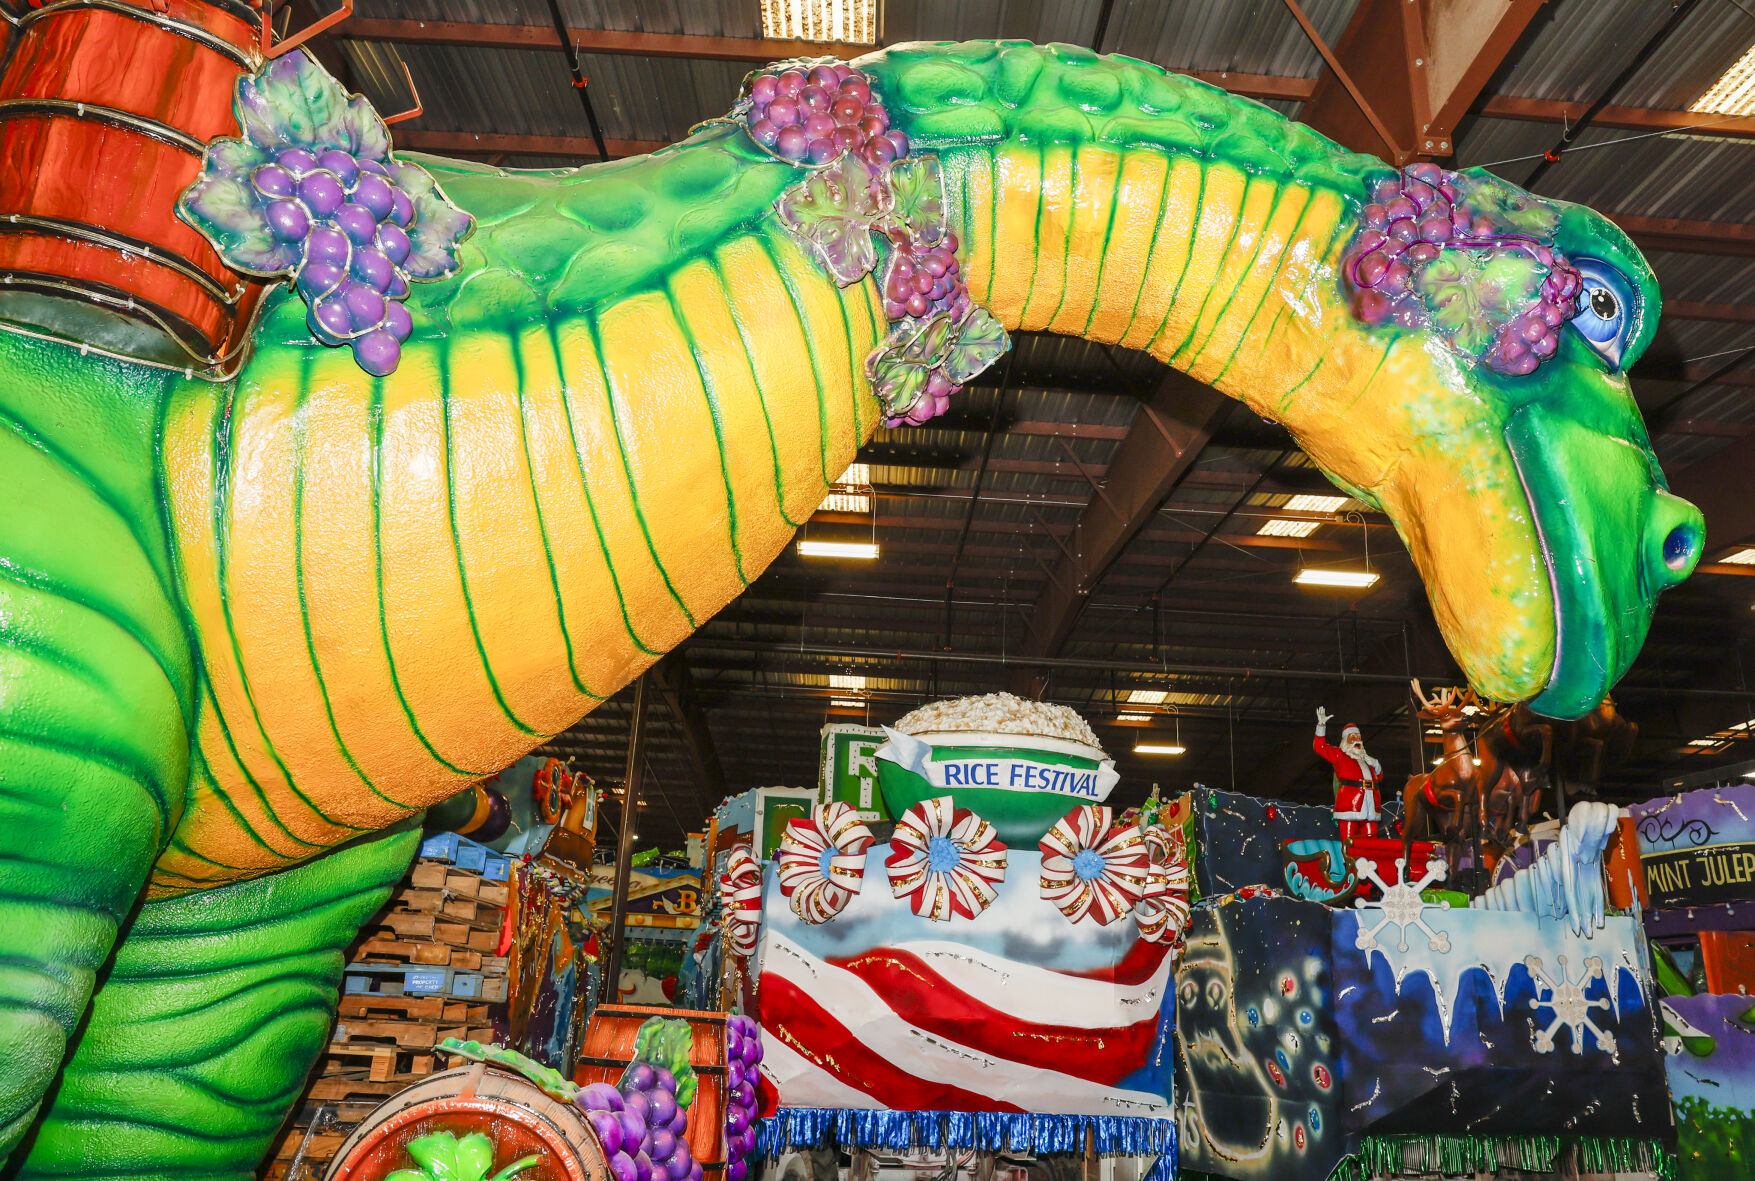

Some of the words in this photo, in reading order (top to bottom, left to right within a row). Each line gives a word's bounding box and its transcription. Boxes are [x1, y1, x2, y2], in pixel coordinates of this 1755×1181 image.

[944, 763, 999, 786] RICE
[1008, 763, 1099, 796] FESTIVAL
[1648, 860, 1691, 895] MINT
[1696, 853, 1755, 886] JULEP
